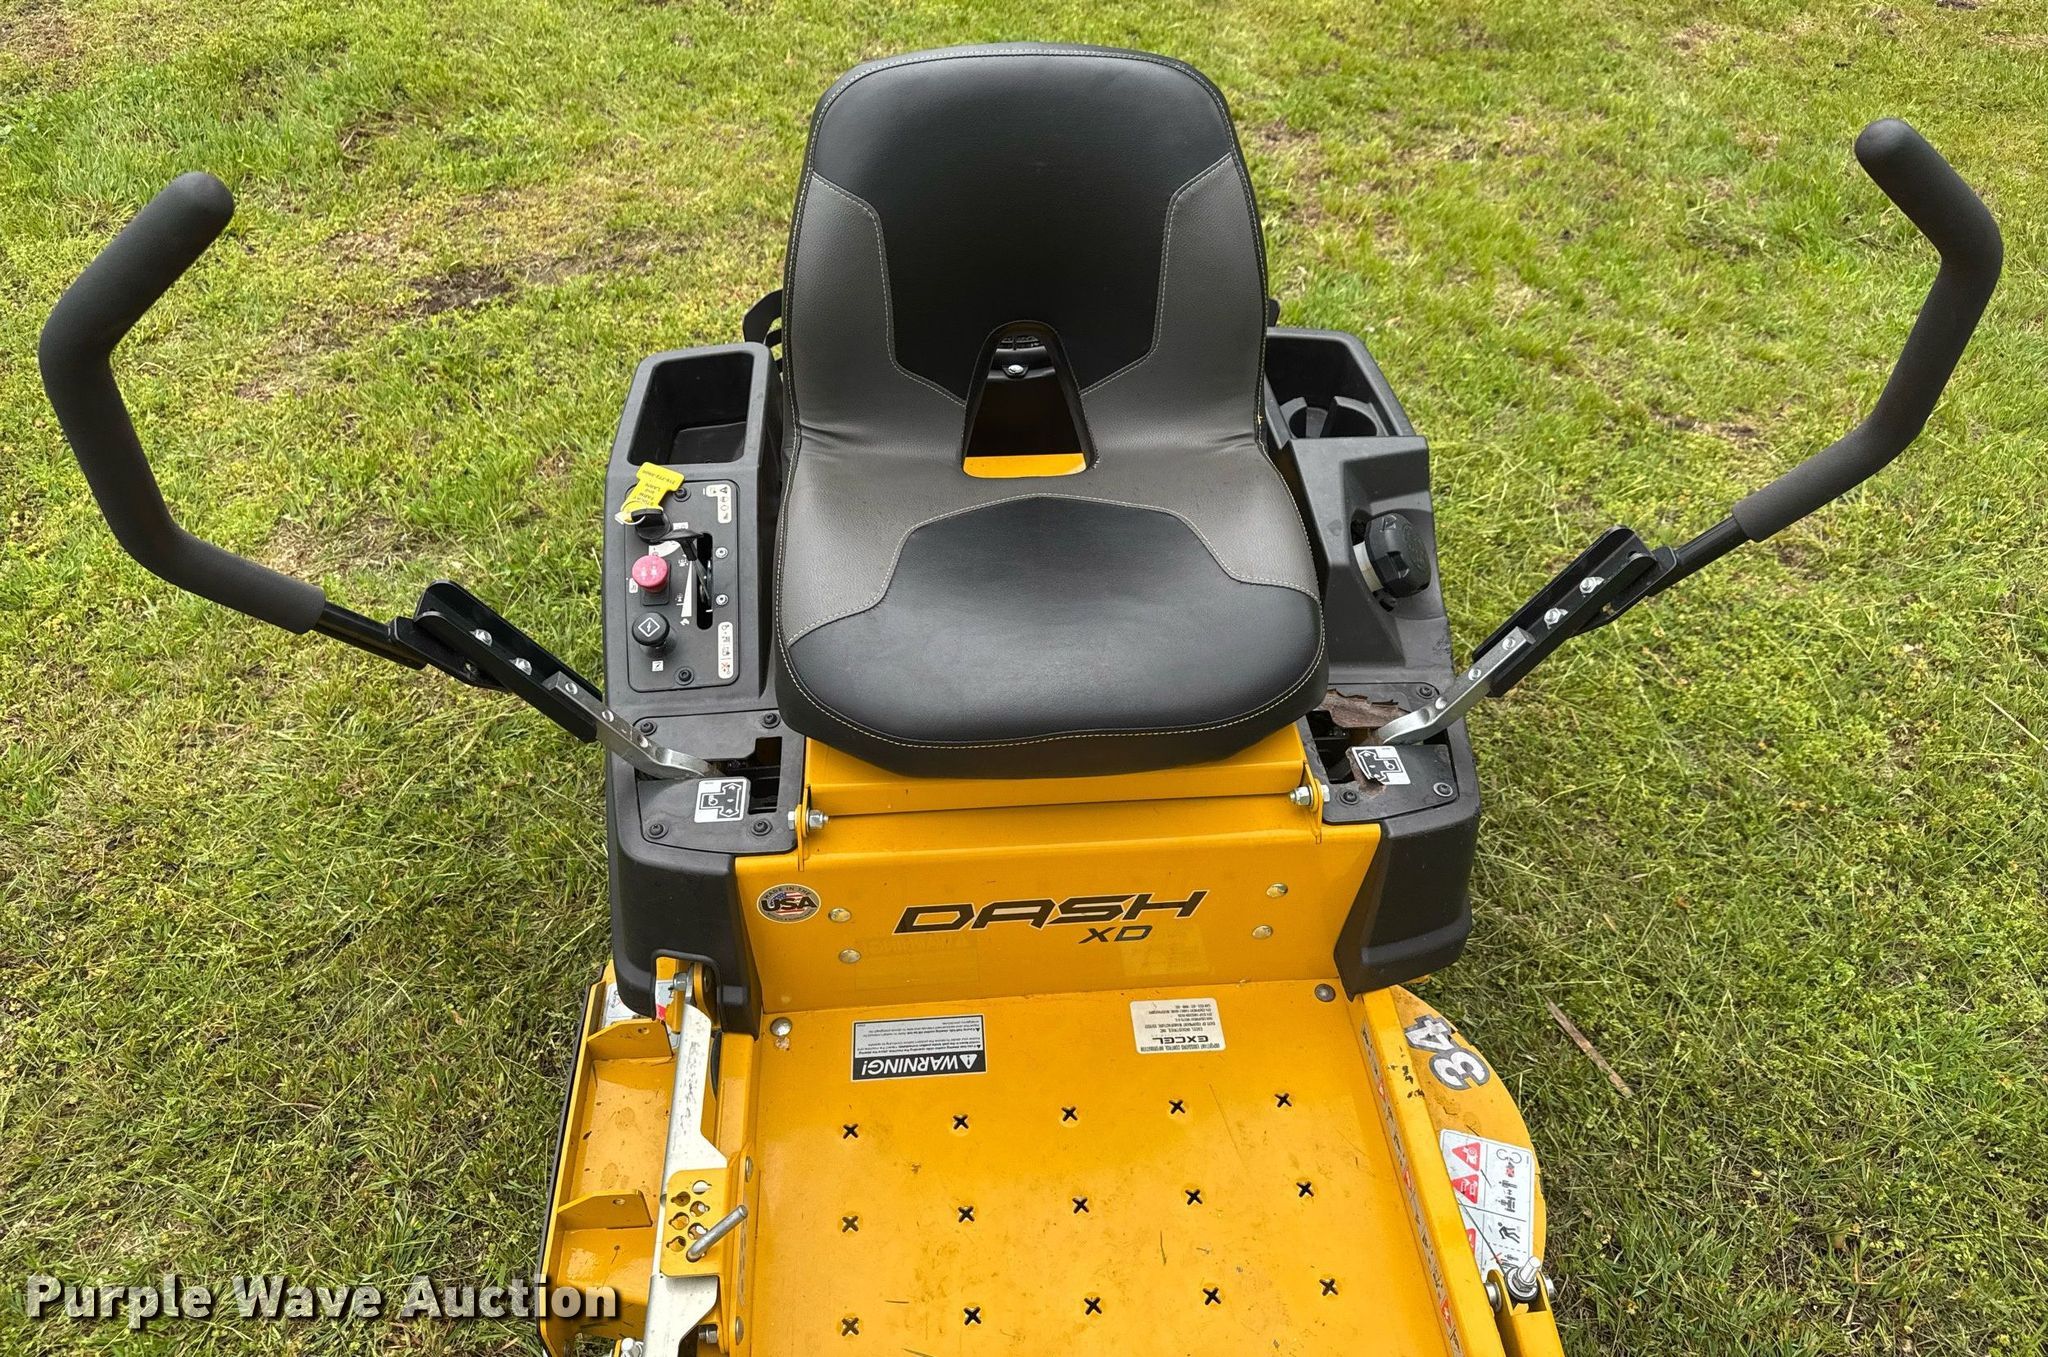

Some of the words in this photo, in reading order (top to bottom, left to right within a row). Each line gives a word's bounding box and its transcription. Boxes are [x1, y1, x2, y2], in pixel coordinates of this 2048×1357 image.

[761, 896, 818, 912] USA
[892, 889, 1208, 934] DASH
[1078, 924, 1153, 944] XD
[1152, 1035, 1209, 1045] EXCEL
[1404, 1014, 1490, 1090] 34
[861, 1055, 958, 1076] WARNING!
